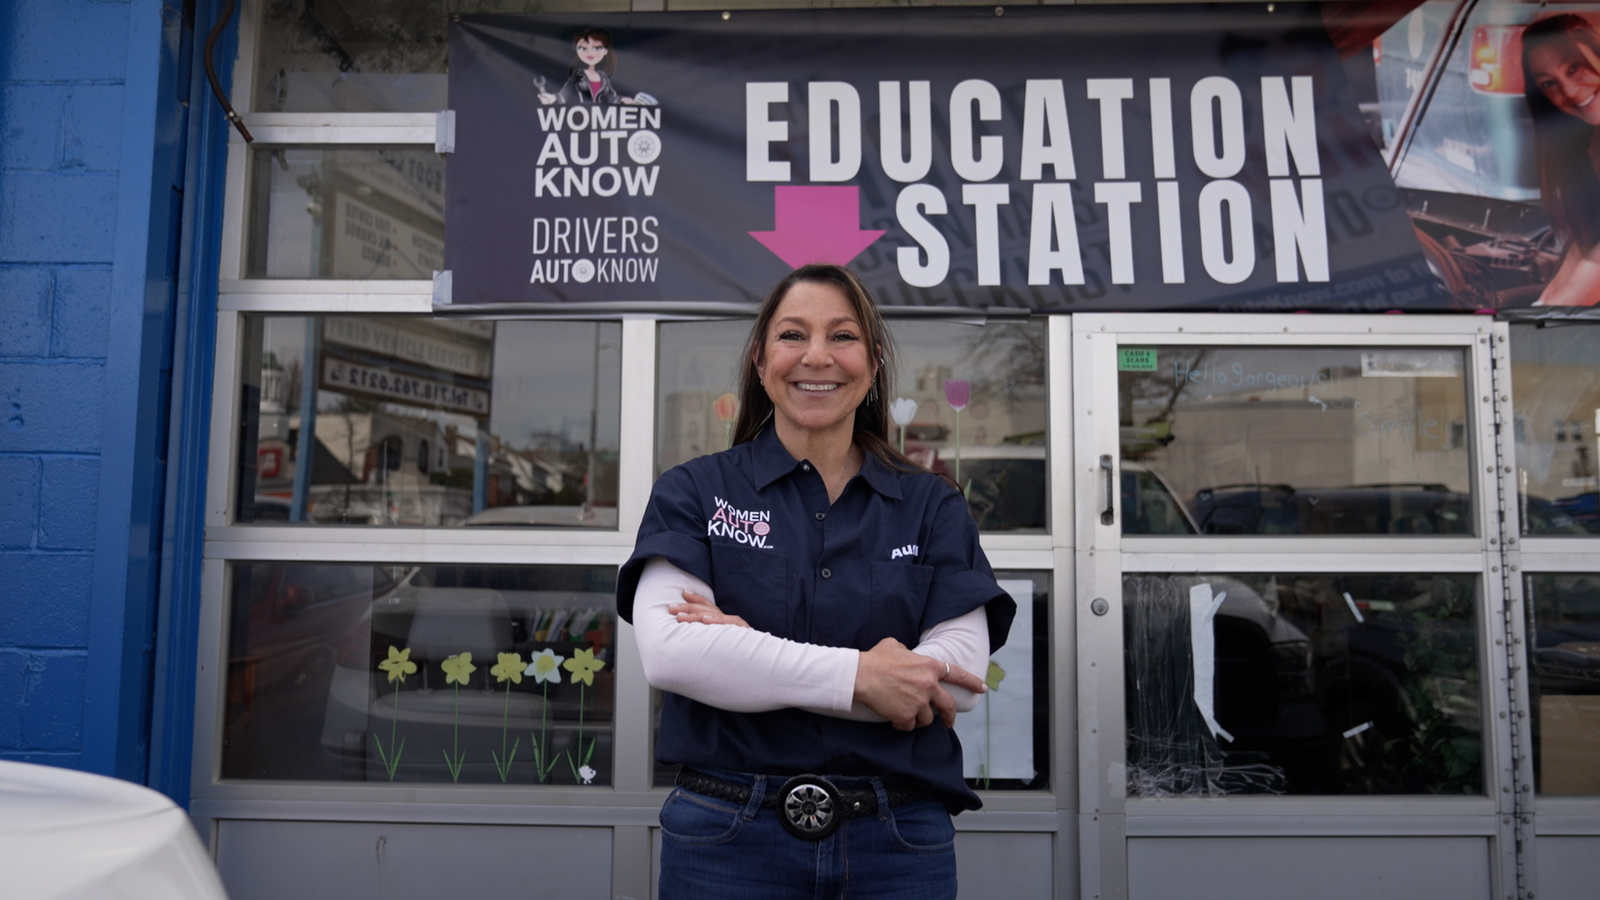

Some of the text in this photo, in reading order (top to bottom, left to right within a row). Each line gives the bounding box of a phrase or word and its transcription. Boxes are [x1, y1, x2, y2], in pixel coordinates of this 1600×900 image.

[537, 105, 661, 131] WOMEN
[745, 76, 1322, 182] EDUCATION
[536, 129, 662, 166] AUTO
[535, 166, 660, 198] KNOW
[532, 216, 659, 255] DRIVERS
[896, 178, 1330, 287] STATION
[1174, 361, 1228, 387] Hello
[711, 507, 771, 536] AUTO
[714, 496, 771, 522] WOMEN
